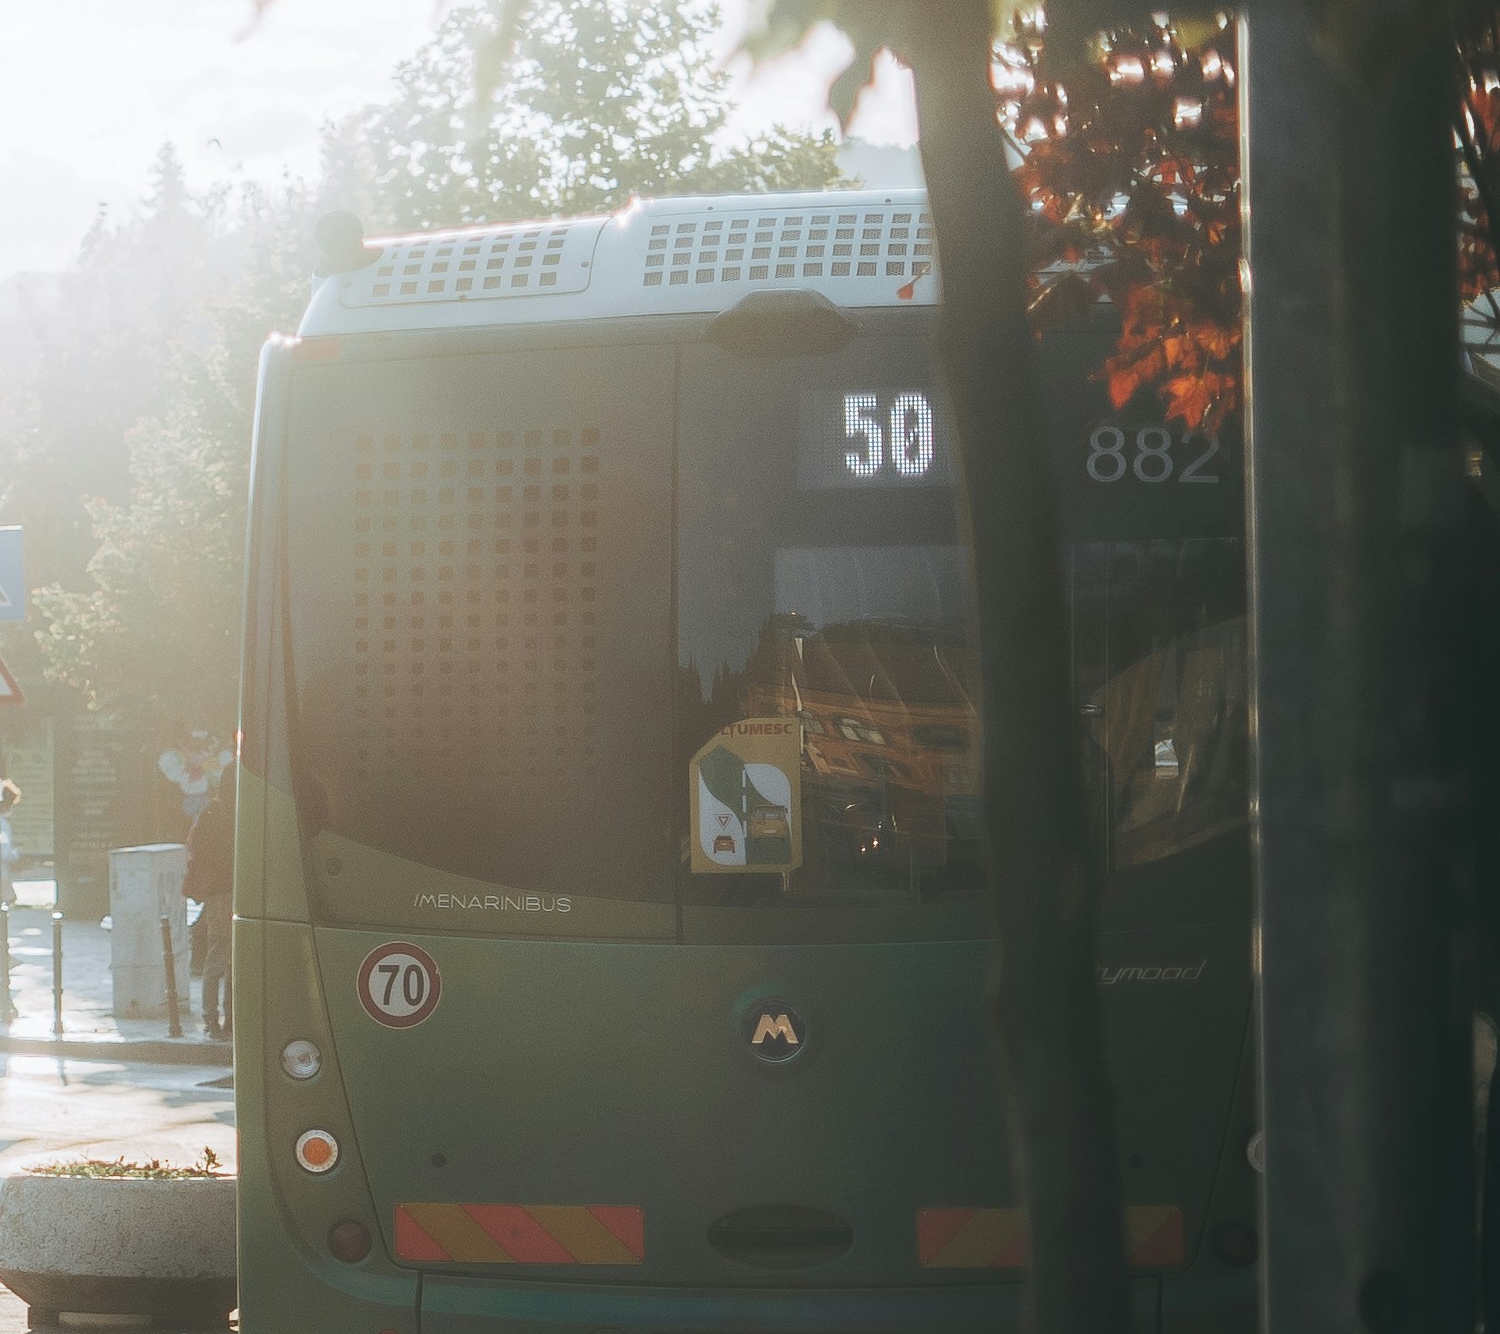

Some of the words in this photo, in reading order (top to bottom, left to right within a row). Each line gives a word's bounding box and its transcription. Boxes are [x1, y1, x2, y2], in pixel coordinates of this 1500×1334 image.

[843, 394, 934, 477] 50
[1086, 425, 1220, 483] 882
[378, 964, 425, 1006] 70
